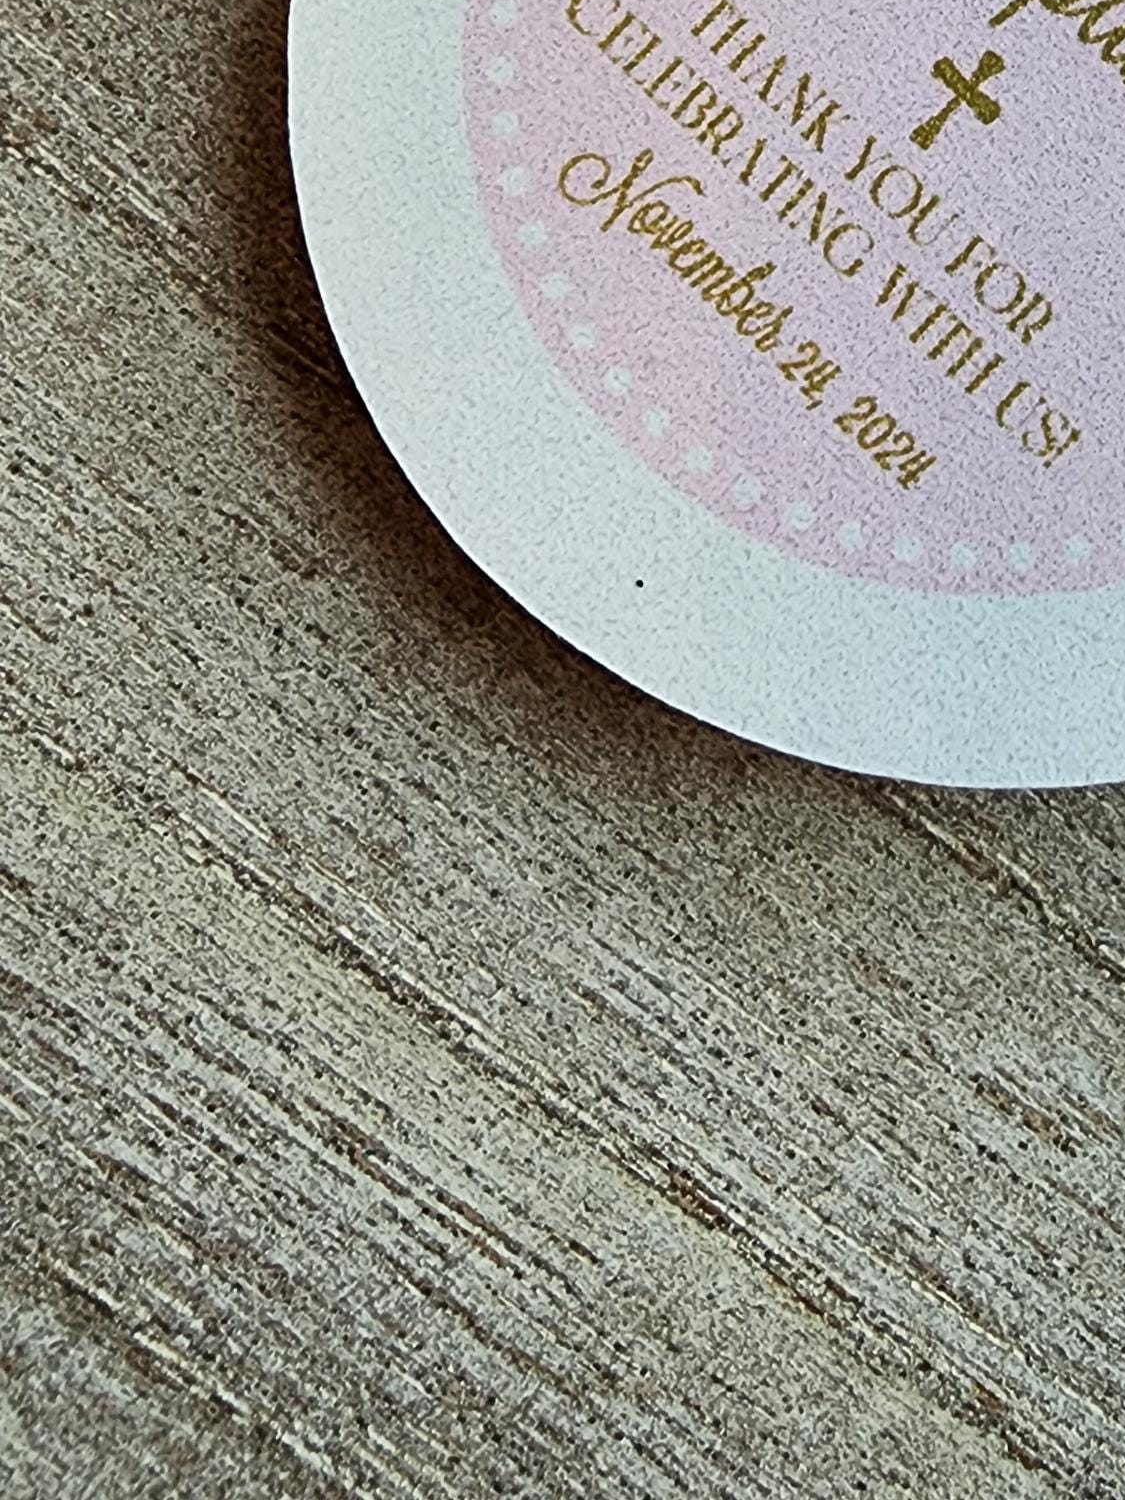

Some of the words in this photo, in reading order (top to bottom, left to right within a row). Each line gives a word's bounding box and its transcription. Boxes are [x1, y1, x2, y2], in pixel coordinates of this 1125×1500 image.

[557, 147, 794, 352] November
[777, 341, 842, 410] 24,
[834, 396, 937, 489] 2024
[845, 135, 959, 246] YOU
[945, 235, 1052, 345] FOR
[876, 264, 1006, 394] WITH
[996, 380, 1081, 468] US!
